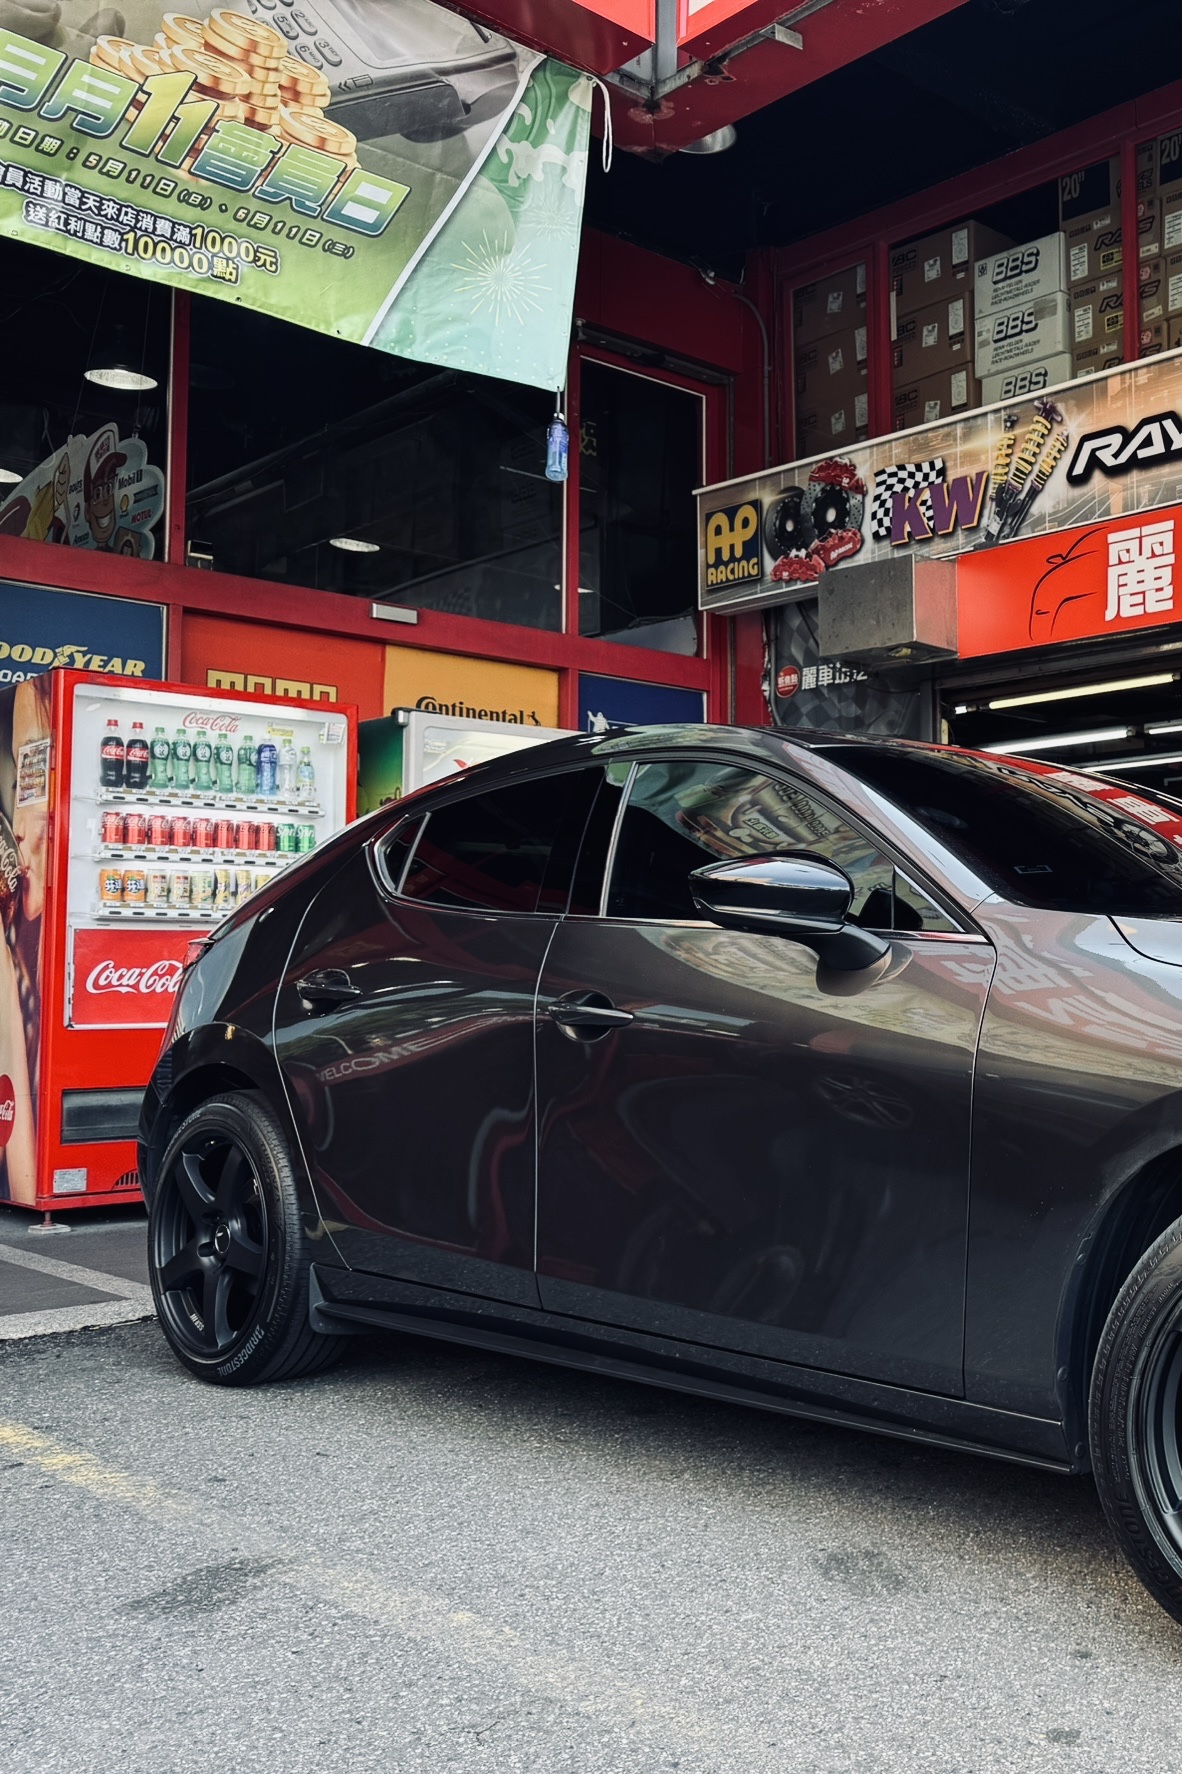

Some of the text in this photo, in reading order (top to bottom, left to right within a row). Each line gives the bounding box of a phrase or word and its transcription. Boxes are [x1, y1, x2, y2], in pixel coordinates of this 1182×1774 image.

[0, 162, 279, 272] 員活動當天來店消費滿1000元
[26, 202, 238, 283] 送紅利點數10000點
[992, 246, 1040, 285] BBS
[992, 306, 1039, 344] BBS
[1001, 366, 1048, 400] BBS
[890, 470, 989, 546] KW
[706, 503, 759, 566] AP
[706, 556, 759, 587] RACING
[182, 711, 242, 734] Coca-Cola
[415, 695, 524, 725] Continental
[85, 960, 183, 994] Coca-Col
[216, 1323, 265, 1378] BRIDGESTONE
